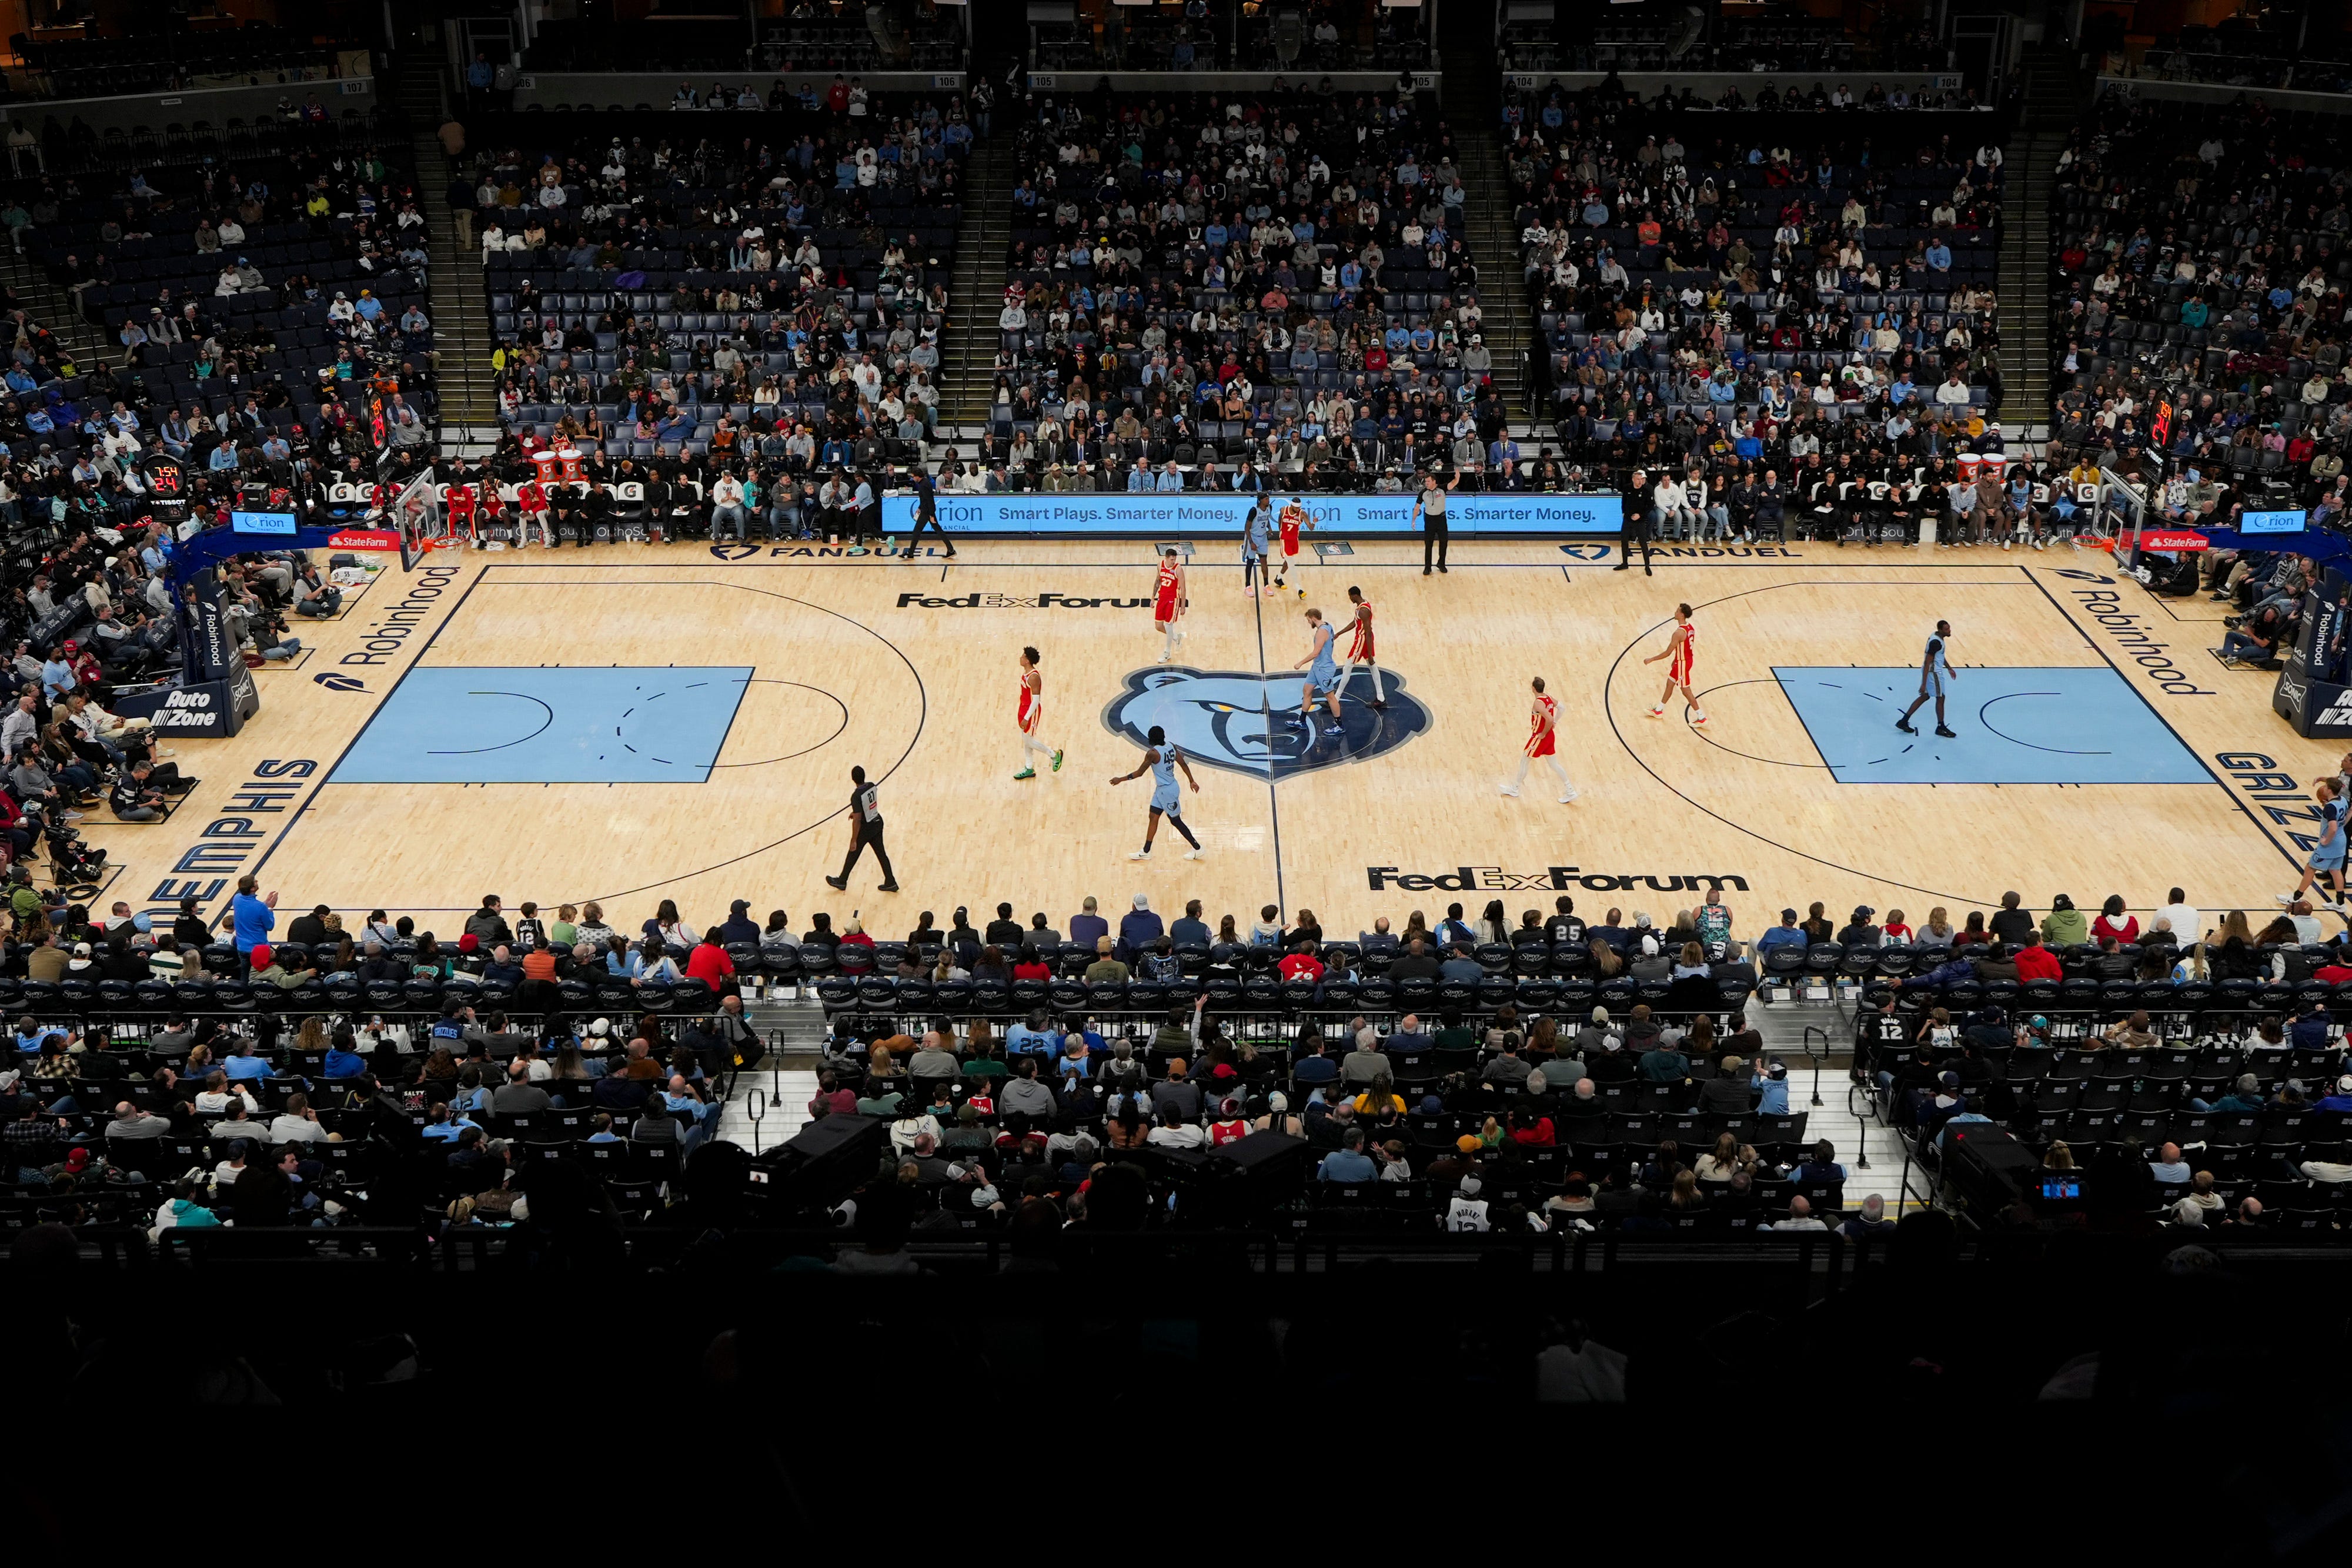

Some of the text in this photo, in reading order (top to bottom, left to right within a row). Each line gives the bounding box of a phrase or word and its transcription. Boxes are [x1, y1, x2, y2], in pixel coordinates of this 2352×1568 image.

[347, 83, 362, 92] 107
[940, 77, 955, 86] 106
[1036, 77, 1051, 86] 105
[1517, 77, 1532, 86] 104
[1942, 79, 1957, 87] 104
[155, 466, 178, 476] 7:54
[155, 477, 178, 491] 24
[245, 514, 284, 529] Orion
[999, 507, 1238, 522] Smart Plays. Smarter Money.
[1357, 508, 1408, 520] Smart
[1464, 508, 1532, 520] Smarter
[1536, 508, 1596, 523] Money.
[2254, 514, 2293, 528] Orion
[343, 537, 387, 547] StateFarm
[2162, 537, 2207, 547] StateFarm
[1627, 547, 1803, 557] FANDUEL
[1161, 578, 1172, 587] 27
[339, 566, 460, 666] Robinhood
[205, 614, 223, 666] Robinhood
[2071, 590, 2217, 696] Robinhood
[2314, 613, 2331, 666] Robinhood
[235, 679, 249, 702] SONIC
[2283, 681, 2302, 703] SONIC
[165, 690, 211, 708] Auto
[166, 709, 216, 726] Zone
[1164, 748, 1175, 764] 45
[867, 791, 875, 803] 27
[1367, 867, 1750, 891] FedExForum
[520, 932, 534, 945] 12
[1555, 924, 1581, 941] 25
[1156, 965, 1174, 982] 12
[1879, 1025, 1903, 1040] 12
[1020, 1038, 1044, 1053] 22
[1220, 1135, 1238, 1144] YOUNG
[1456, 1208, 1480, 1220] MORANT
[1457, 1221, 1478, 1232] 12
